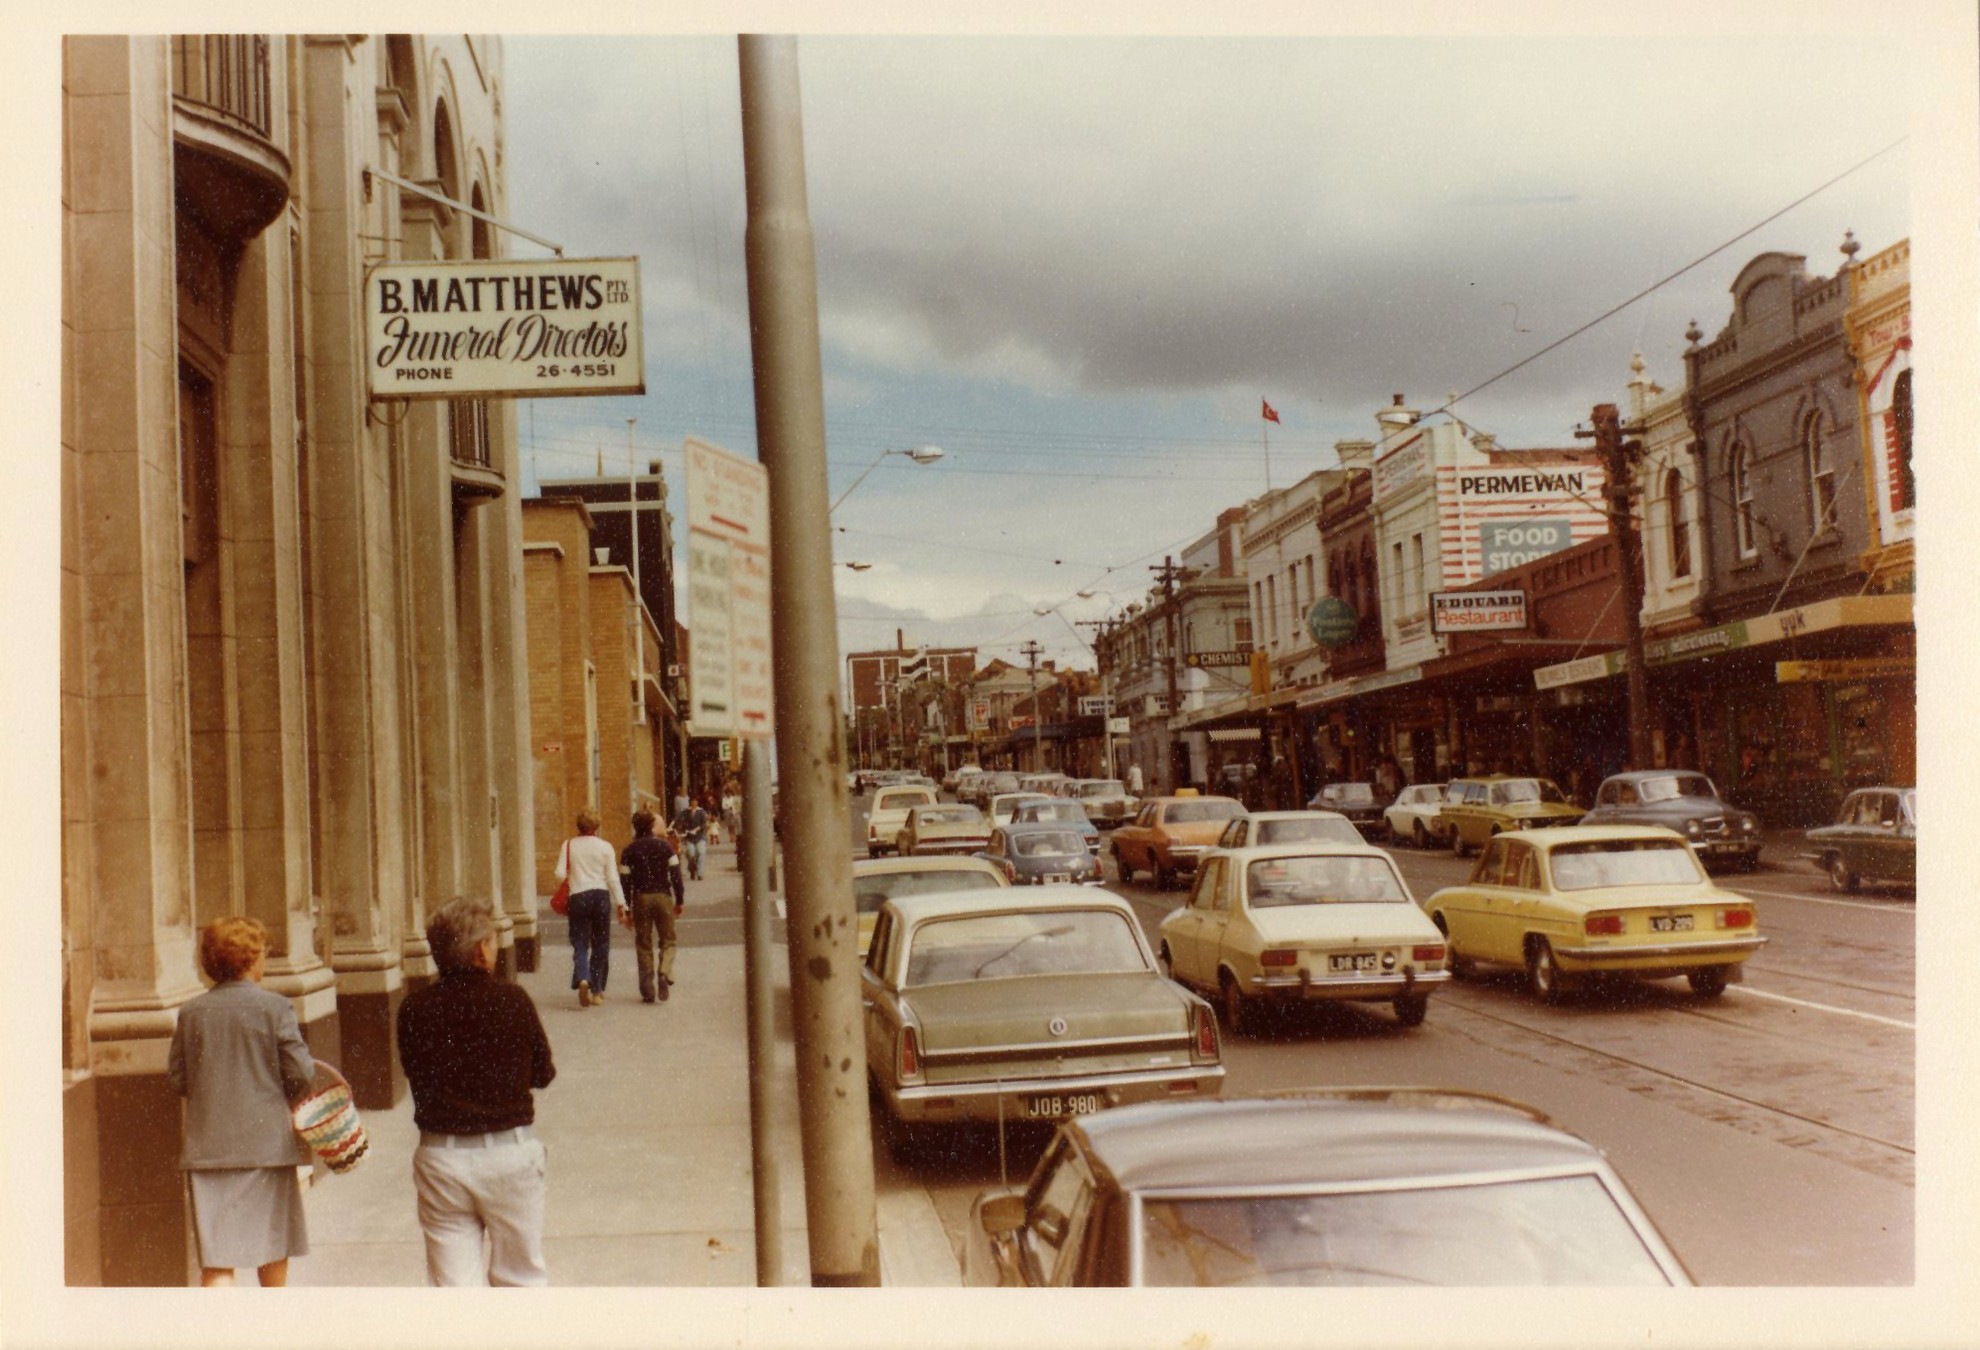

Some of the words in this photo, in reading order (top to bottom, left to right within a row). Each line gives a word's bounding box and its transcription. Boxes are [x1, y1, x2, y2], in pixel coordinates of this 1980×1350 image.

[606, 292, 629, 304] LTD
[376, 315, 516, 368] Funeral
[510, 313, 629, 363] Directors
[396, 367, 454, 381] PHONE
[1460, 472, 1583, 495] PERMEWAN
[1494, 527, 1559, 547] FOOD
[1488, 550, 1553, 570] STOR
[1437, 595, 1523, 608] EDOUARD
[1437, 608, 1525, 626] Restaurant
[1200, 653, 1250, 666] CHEMIST
